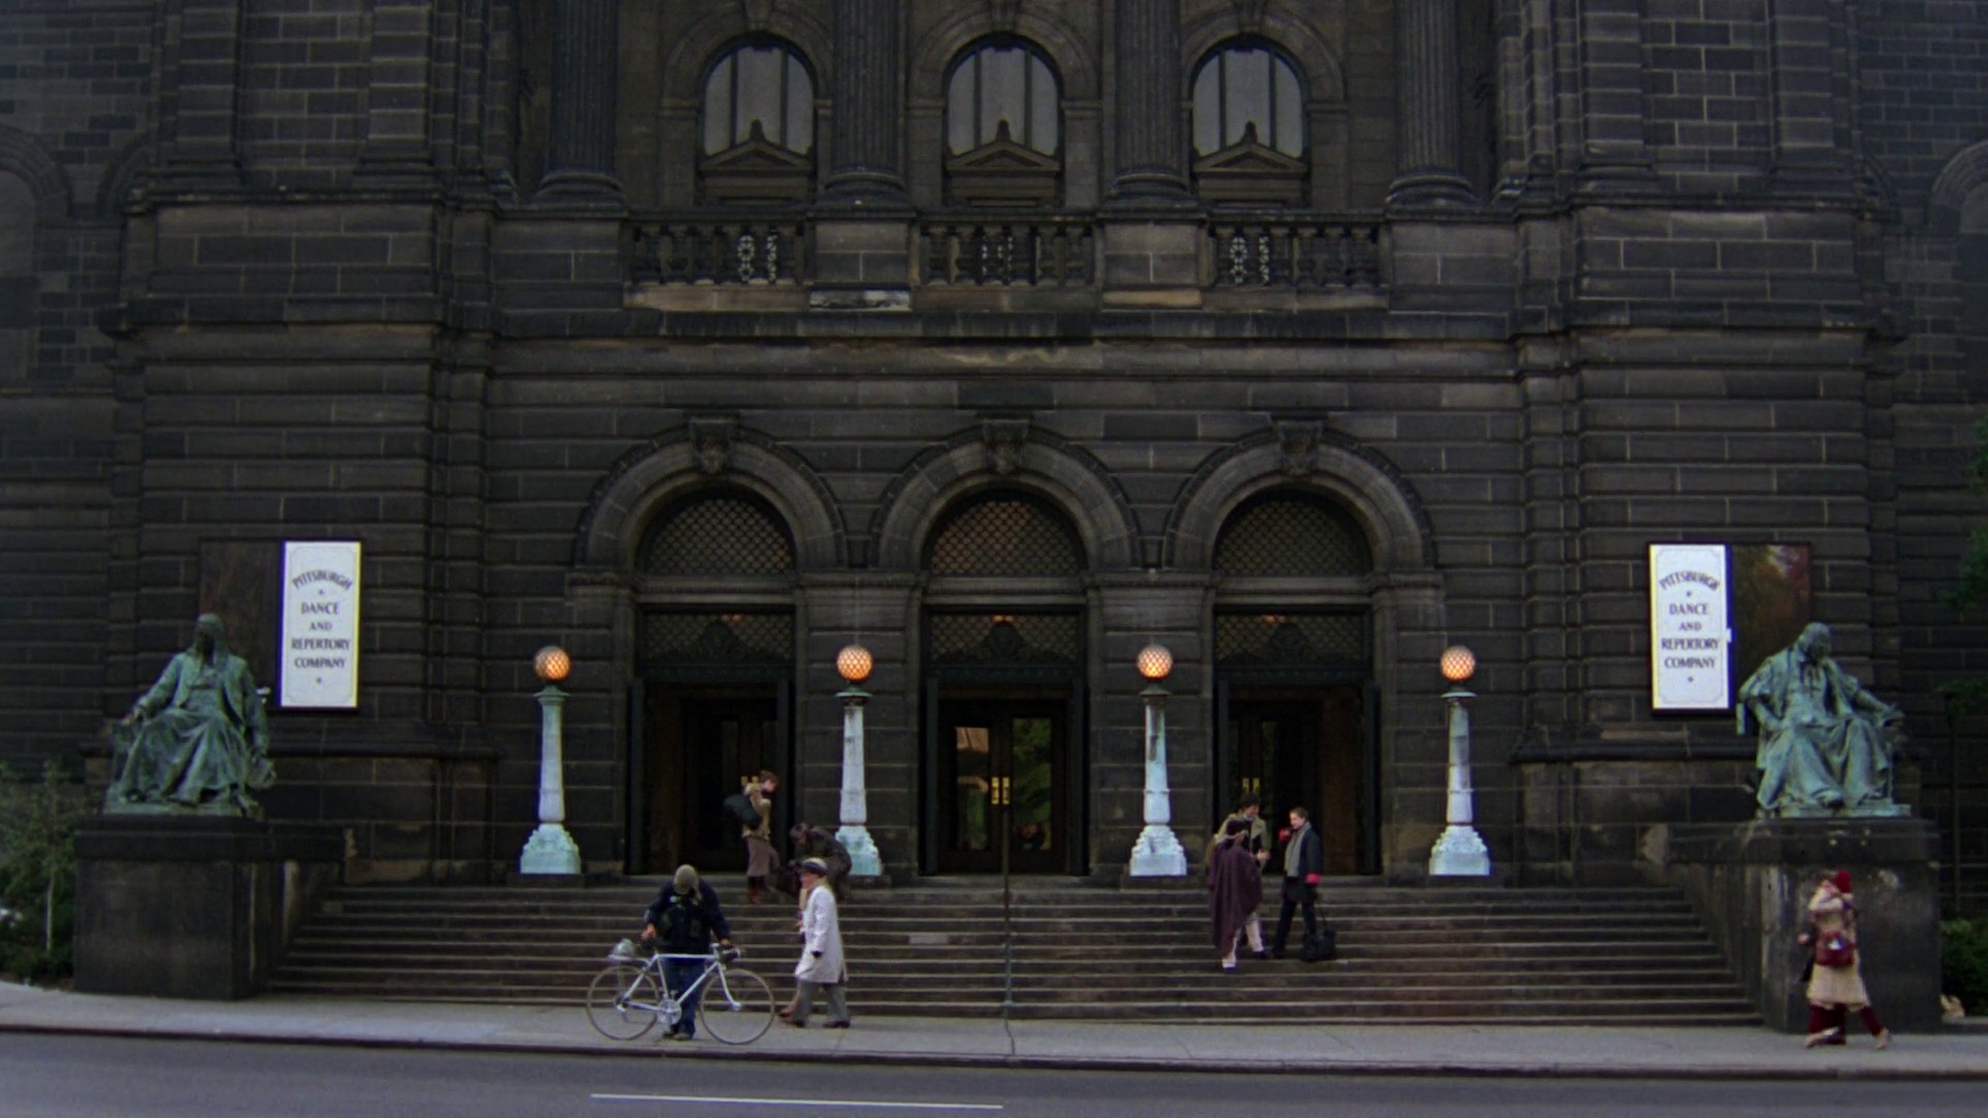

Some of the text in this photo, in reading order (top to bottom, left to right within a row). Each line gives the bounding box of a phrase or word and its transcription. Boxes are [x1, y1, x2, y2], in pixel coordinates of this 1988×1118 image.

[292, 570, 353, 591] PITTSBURGH
[1659, 570, 1721, 592] PITTSBURGH
[301, 602, 339, 615] DANCE
[1669, 603, 1709, 615] DANCE
[309, 621, 332, 631] AND
[1679, 622, 1702, 631] AND
[291, 638, 350, 650] REPERTORY
[1661, 638, 1720, 650] REPERTORY
[294, 657, 346, 669] COMPANY
[1664, 657, 1716, 669] COMPANY
